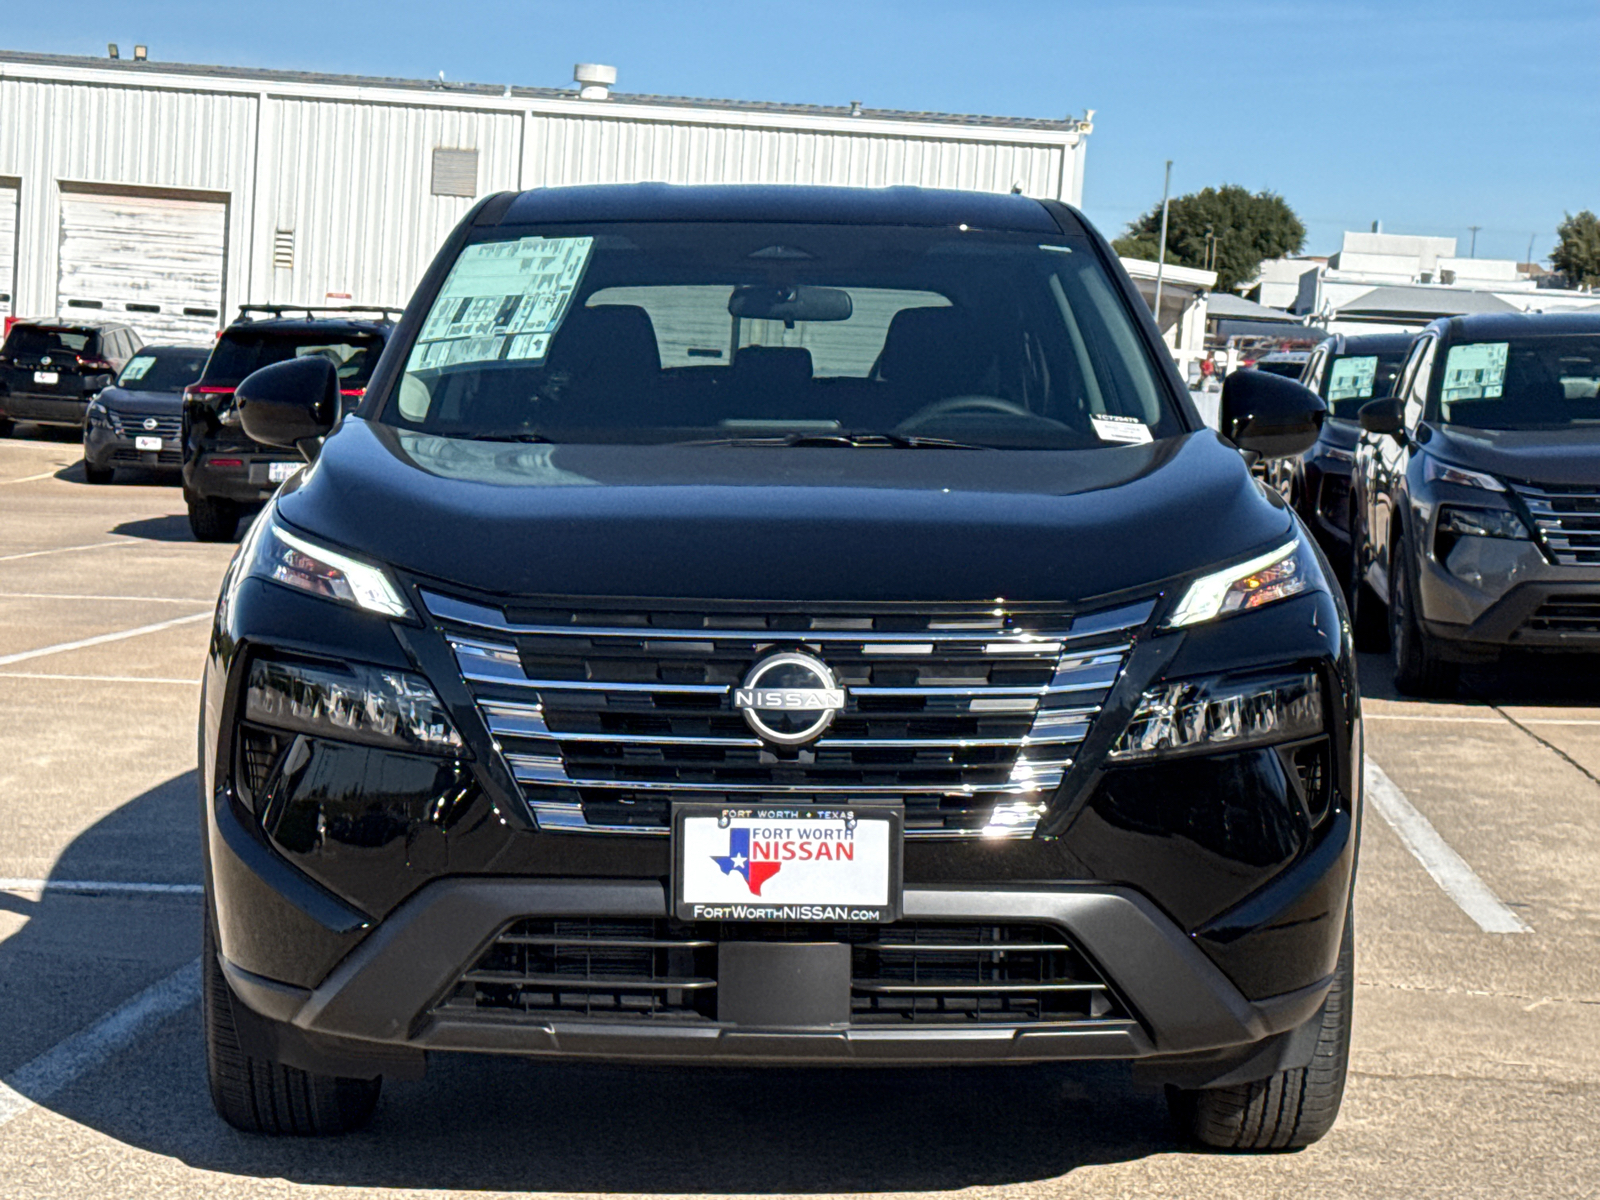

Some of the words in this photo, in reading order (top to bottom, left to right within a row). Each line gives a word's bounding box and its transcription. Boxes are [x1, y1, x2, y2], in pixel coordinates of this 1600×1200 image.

[736, 691, 840, 707] NISSAN
[721, 809, 753, 818] FORT
[757, 810, 799, 819] WORTH
[816, 810, 855, 820] TEXAS
[752, 827, 793, 840] FORT
[797, 828, 854, 840] WORTH
[752, 841, 854, 861] NISSAN
